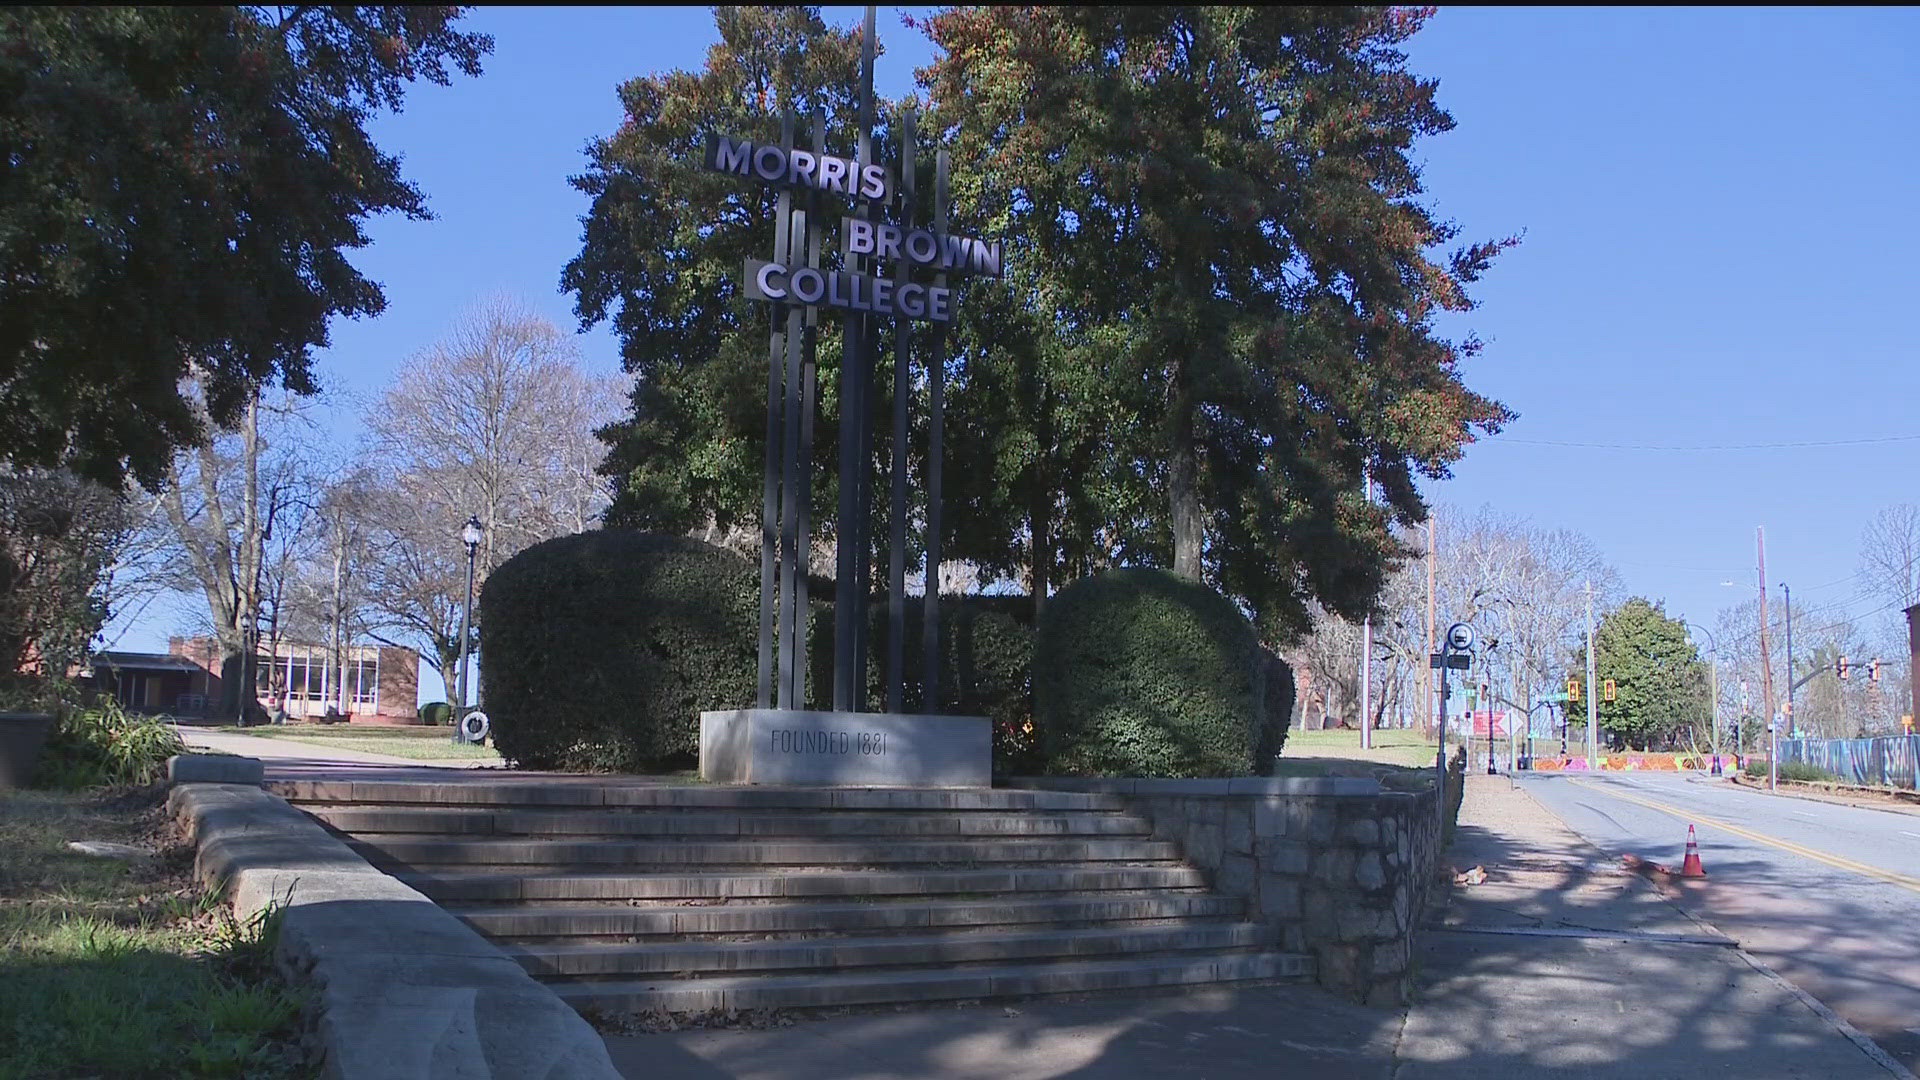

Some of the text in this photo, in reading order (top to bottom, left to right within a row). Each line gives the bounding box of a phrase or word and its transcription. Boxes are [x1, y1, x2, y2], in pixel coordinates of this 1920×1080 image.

[715, 138, 885, 199] MORRIS
[850, 219, 999, 274] BROWN
[756, 262, 949, 321] COLLEGE
[771, 729, 887, 755] FOUNDED 1881
